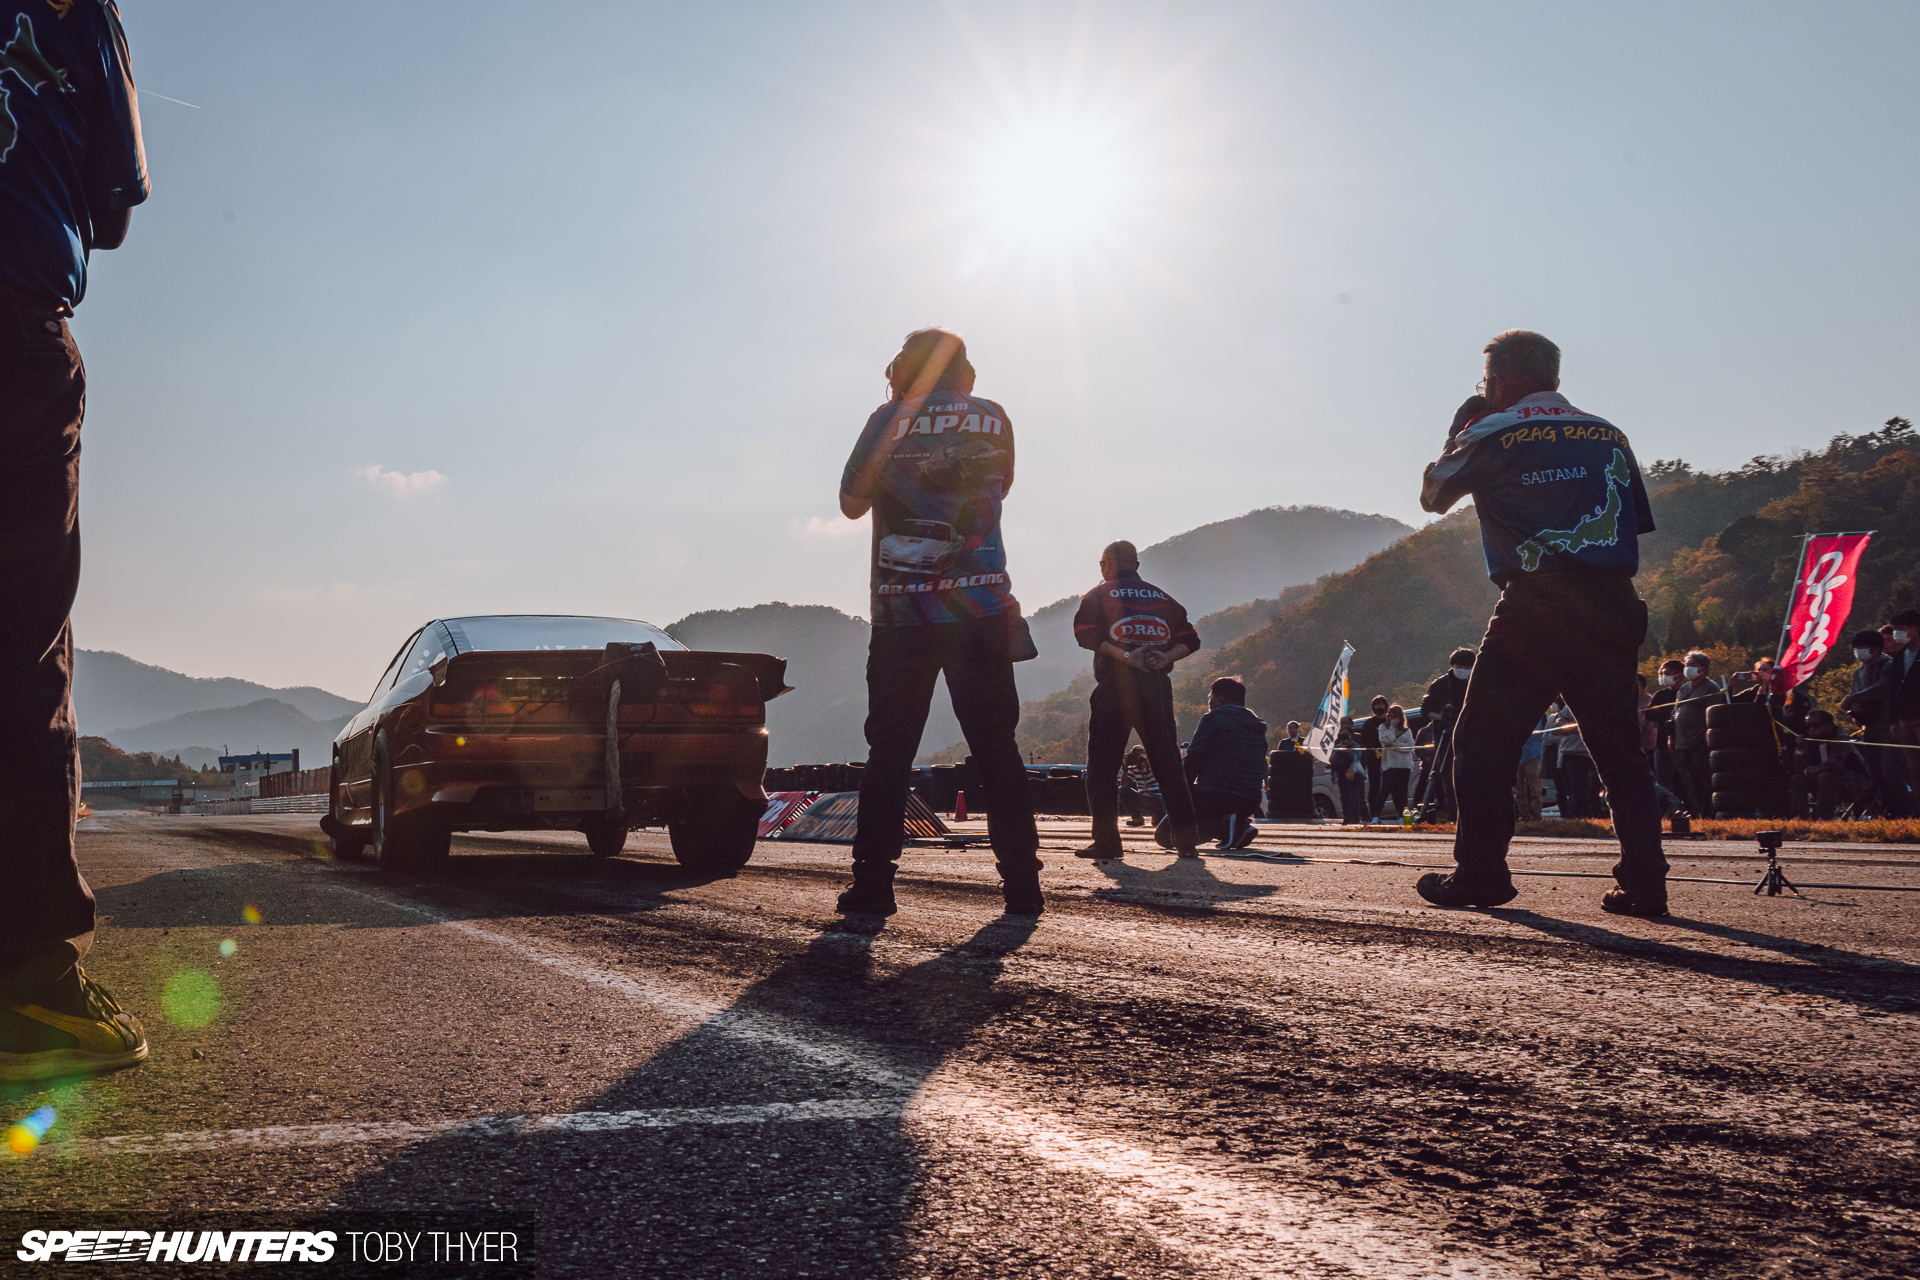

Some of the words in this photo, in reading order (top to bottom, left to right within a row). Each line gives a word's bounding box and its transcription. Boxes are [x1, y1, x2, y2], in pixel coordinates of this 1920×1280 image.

[927, 402, 969, 413] TEAM
[1517, 406, 1595, 420] JAPA
[891, 413, 1002, 442] JAPAN
[1500, 426, 1556, 450] DRAG
[1521, 466, 1588, 486] SAITAMA
[878, 581, 934, 596] DRAG
[937, 572, 1005, 592] RACING
[1109, 588, 1169, 601] OFFICIAL
